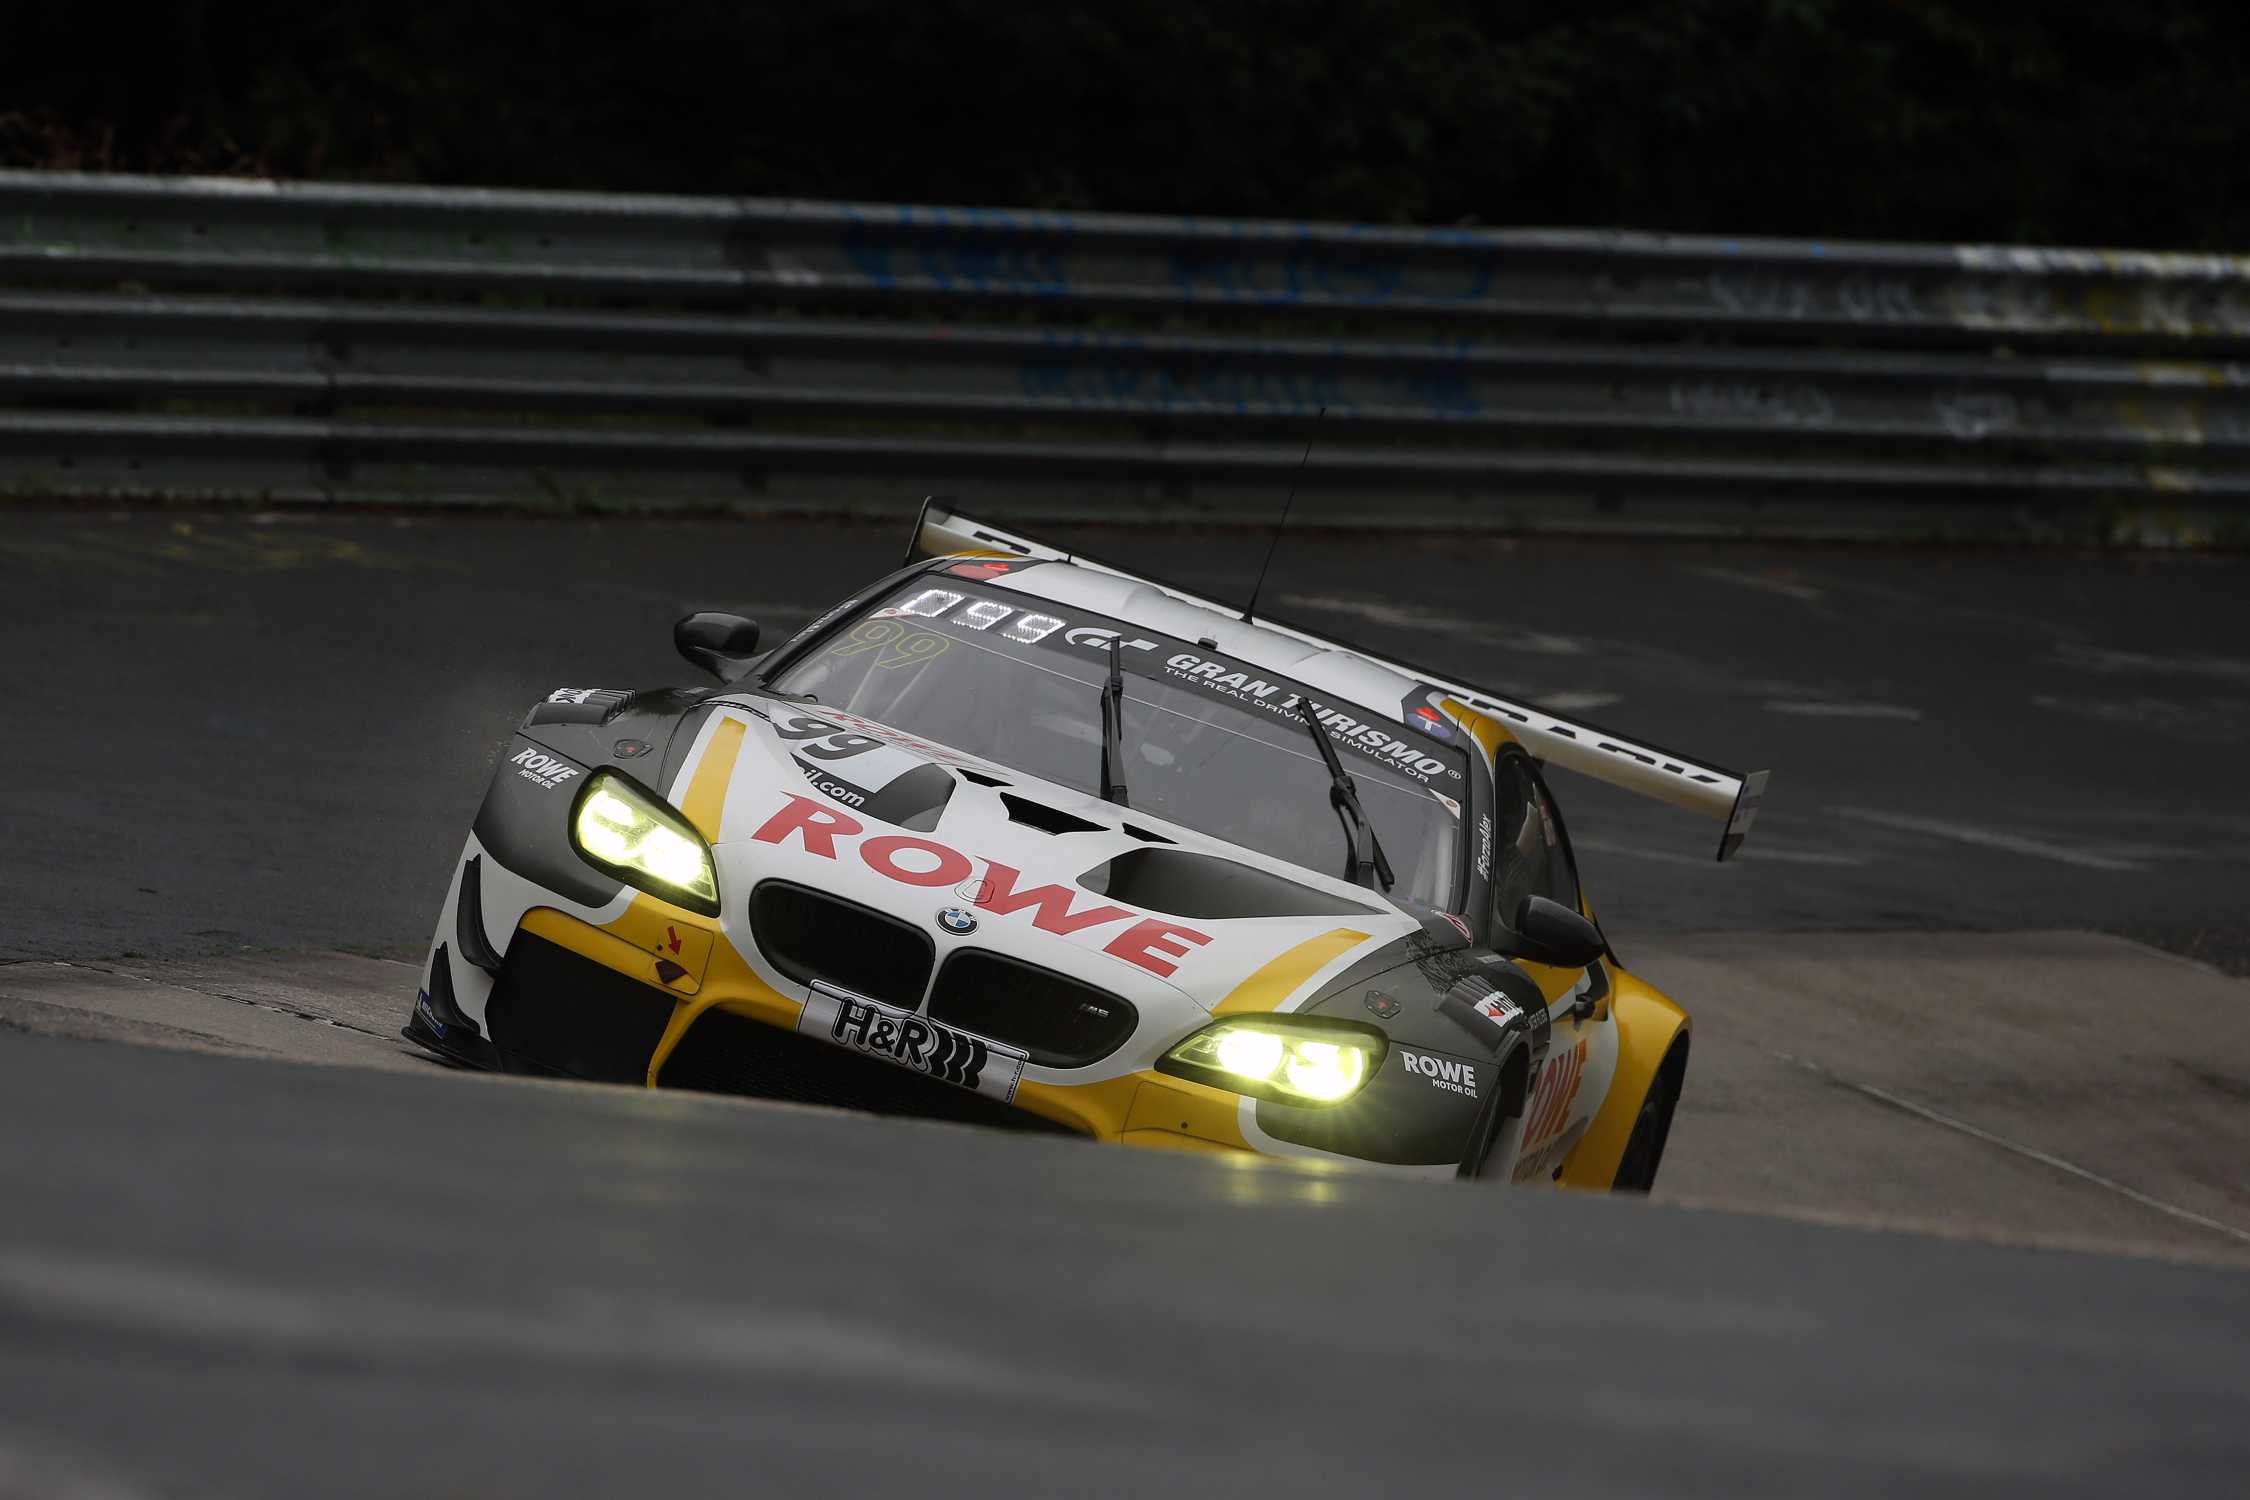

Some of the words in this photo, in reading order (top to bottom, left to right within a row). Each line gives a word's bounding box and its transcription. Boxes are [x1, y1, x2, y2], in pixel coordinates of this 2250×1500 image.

[831, 619, 951, 671] 99
[1166, 653, 1281, 698] GRAN
[772, 717, 887, 761] 99
[1164, 667, 1200, 683] THE
[1203, 680, 1249, 702] REAL
[1253, 699, 1325, 731] DRIVIN
[1329, 730, 1431, 784] SIMULATOR
[509, 747, 580, 784] ROWE
[517, 768, 546, 784] MOTOR
[800, 766, 866, 808] il.com
[750, 789, 1215, 979] ROWE
[1399, 1050, 1476, 1088] ROWE
[1432, 1078, 1464, 1095] MOTOR
[1464, 1087, 1478, 1099] OIL
